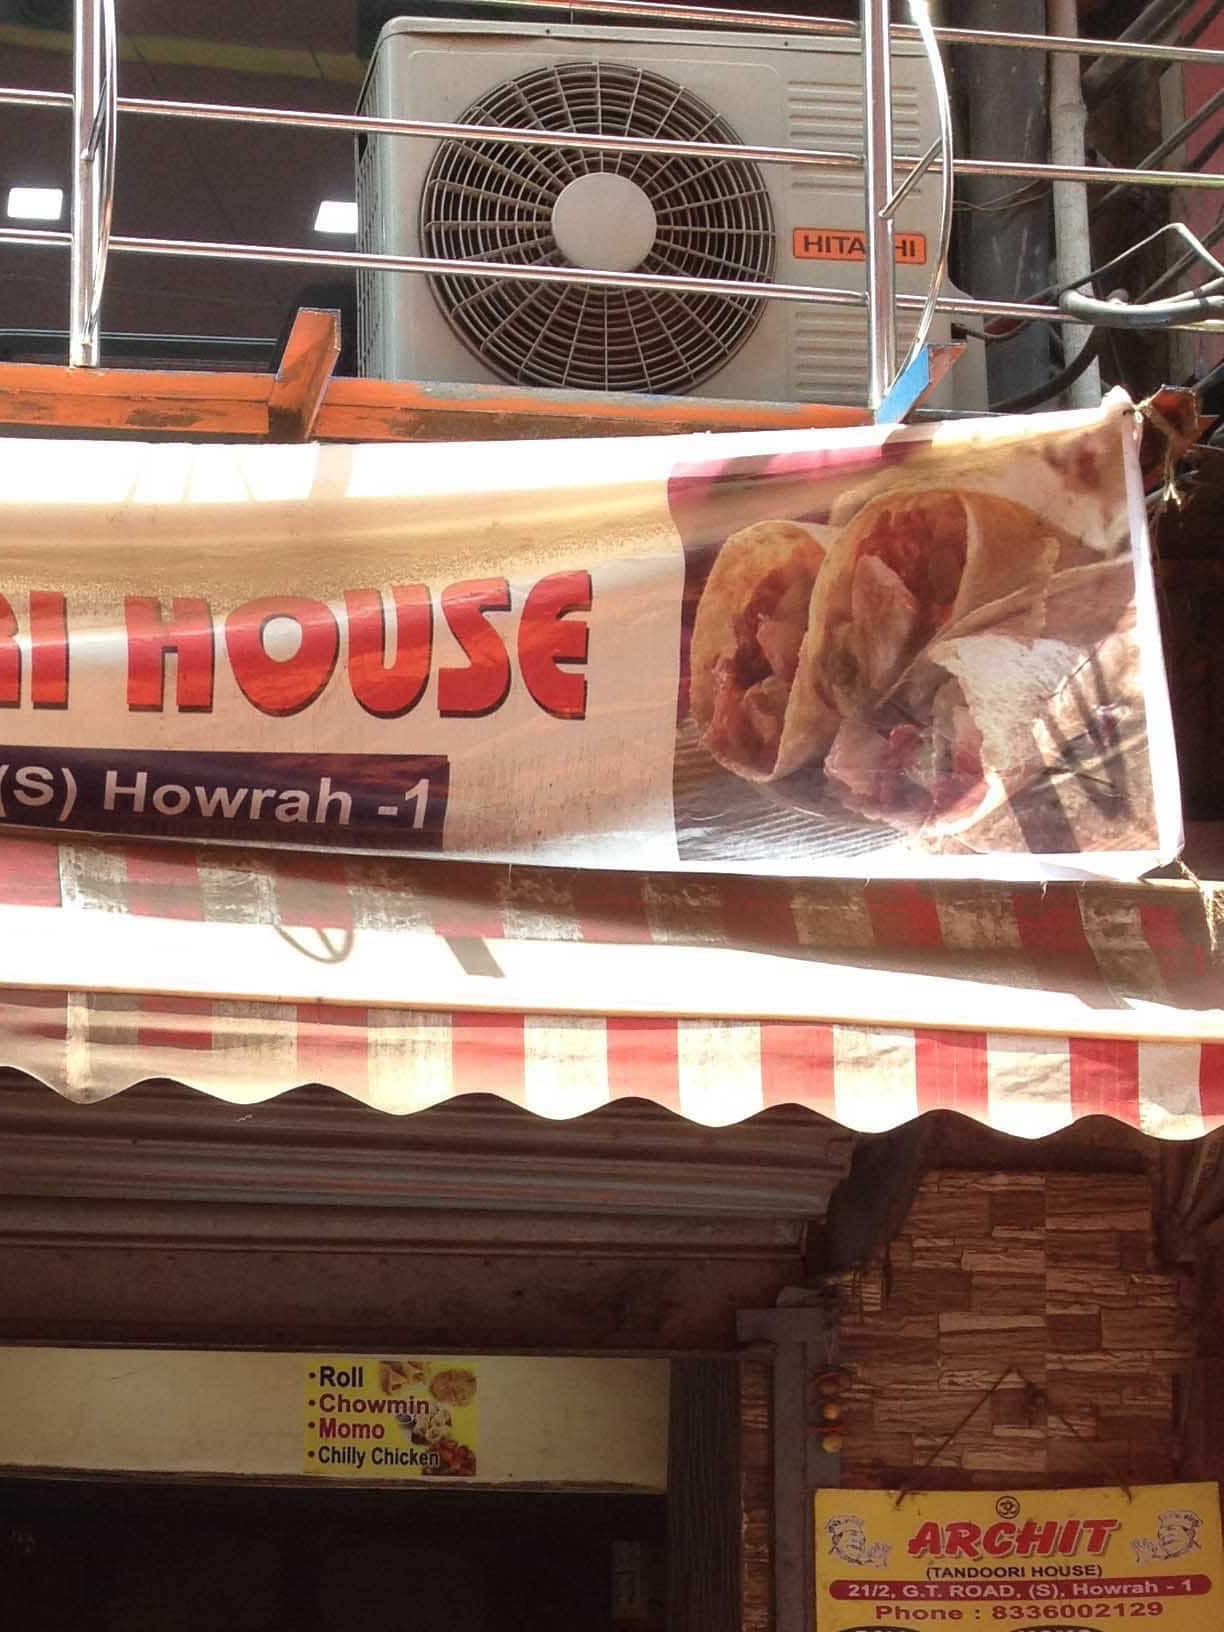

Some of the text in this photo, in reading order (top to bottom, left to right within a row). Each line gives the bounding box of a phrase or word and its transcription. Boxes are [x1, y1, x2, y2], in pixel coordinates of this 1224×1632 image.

[803, 235, 915, 256] HITAHI
[125, 569, 592, 721] HOUSE
[105, 770, 352, 825] Howrah
[319, 1366, 363, 1387] Roll
[319, 1394, 429, 1414] Chowmin
[319, 1419, 385, 1439] Momo
[318, 1447, 440, 1468] Chilly Chicken
[907, 1519, 1119, 1561] ARCHIT
[926, 1565, 1102, 1581] (TANDOORI HOUSE)
[848, 1584, 895, 1599] 21/2,
[1073, 1581, 1158, 1596] Howrah
[876, 1601, 1163, 1620] Phone 8336002129
